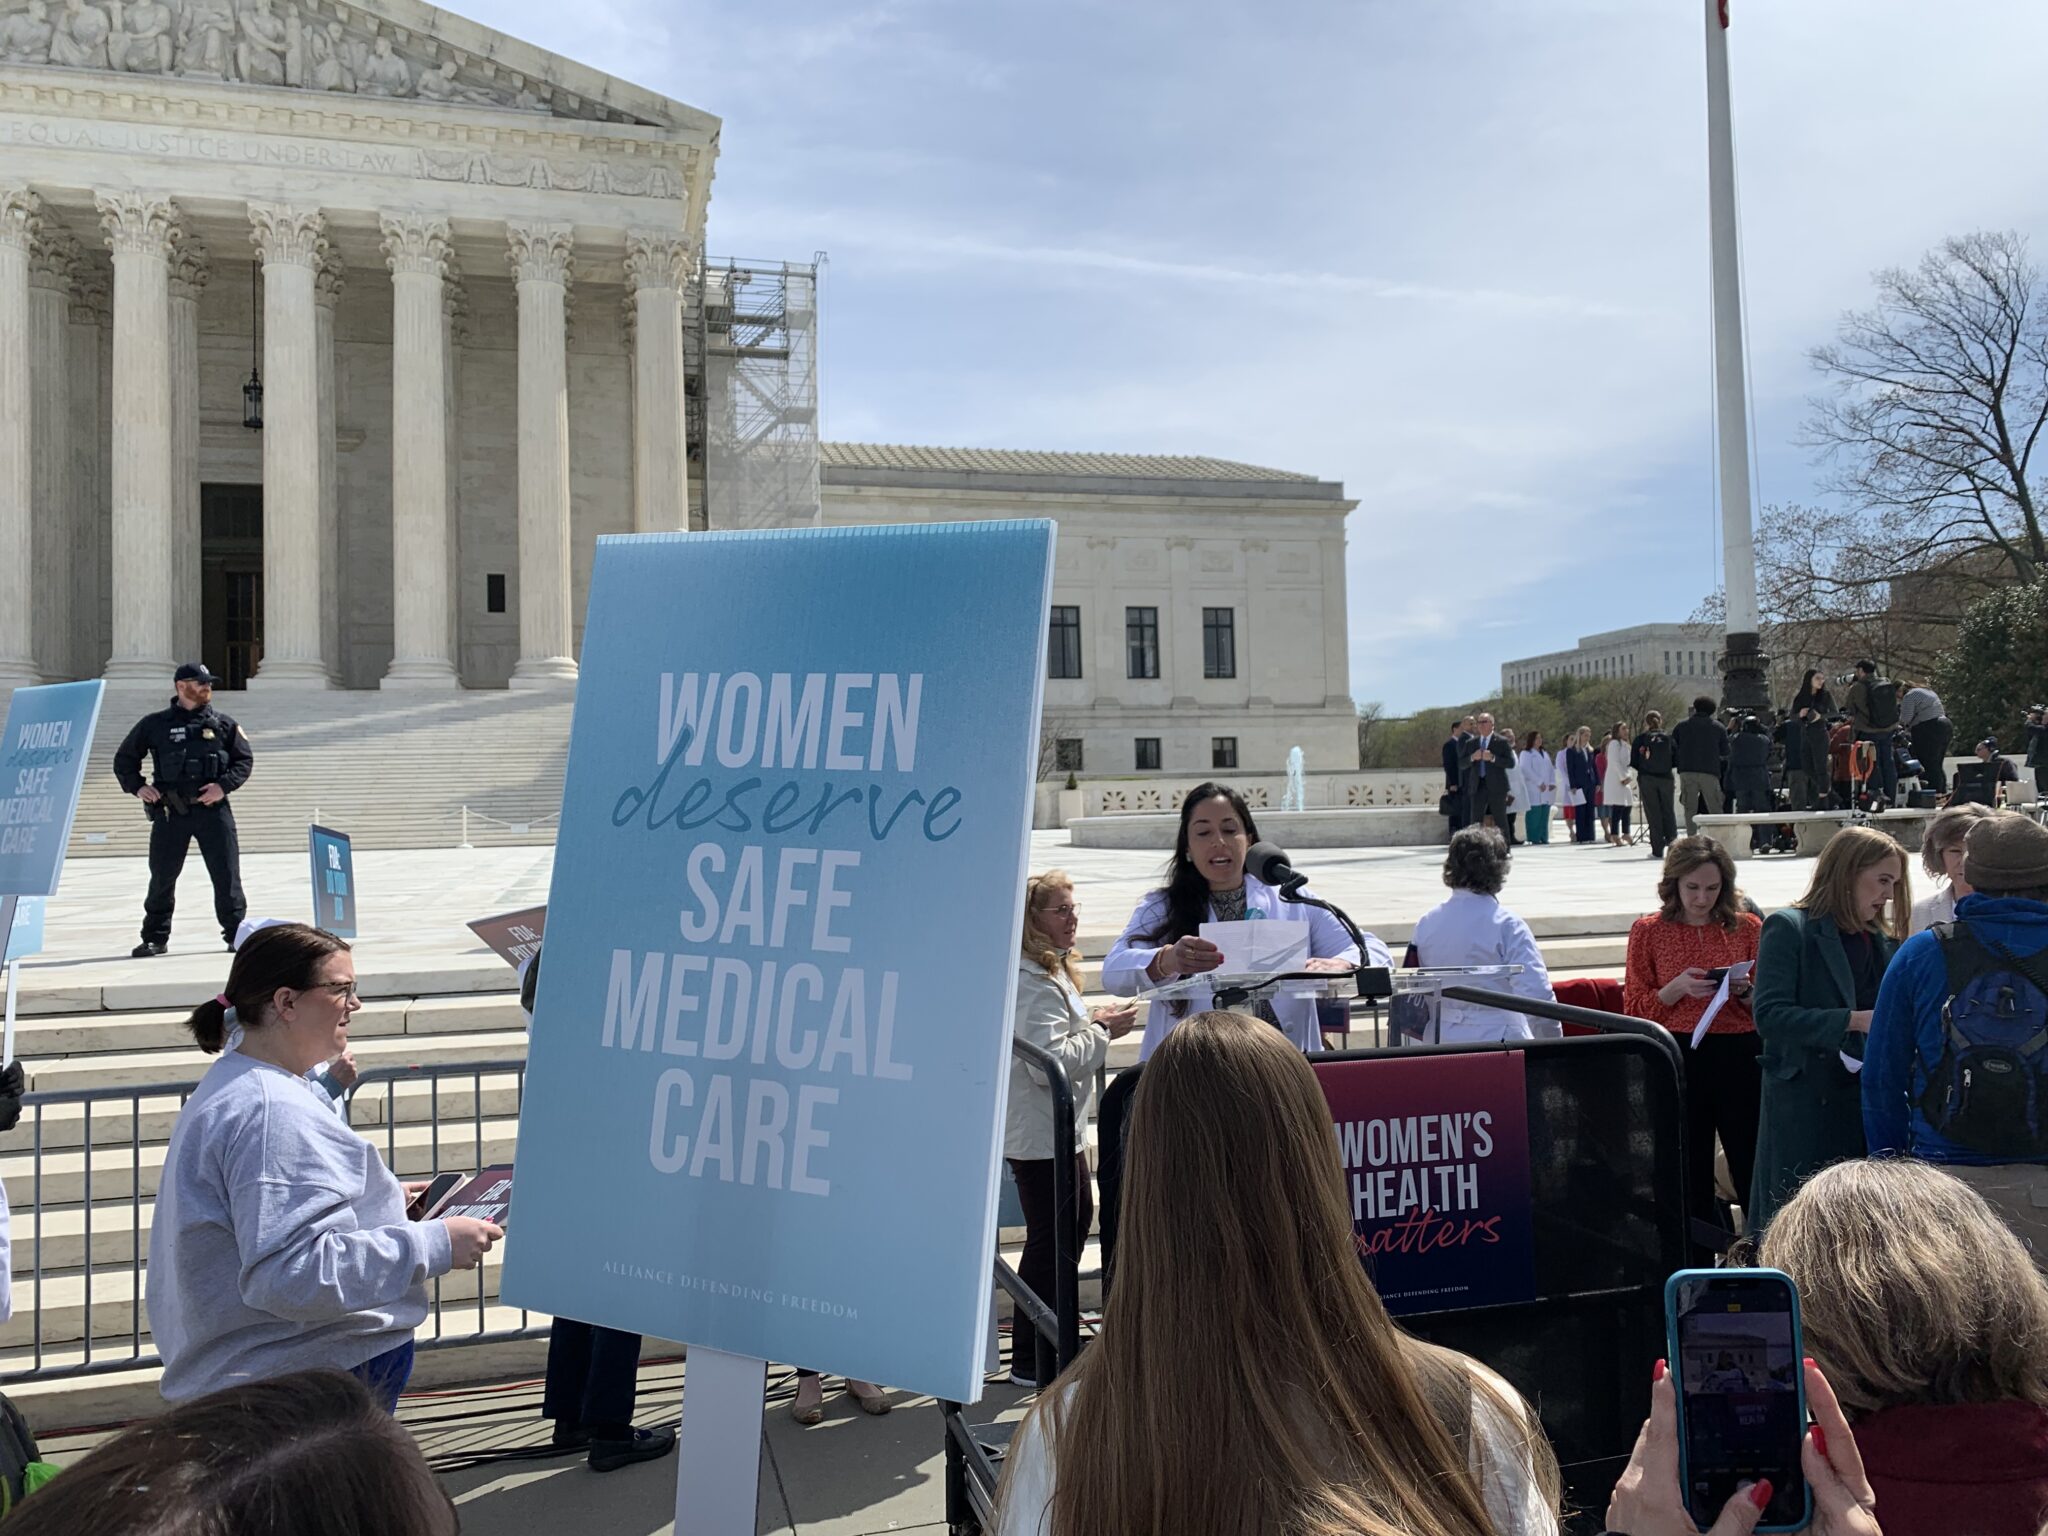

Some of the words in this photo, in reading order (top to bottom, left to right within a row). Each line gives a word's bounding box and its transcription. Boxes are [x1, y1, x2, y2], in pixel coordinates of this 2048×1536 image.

[11, 121, 110, 148] EQUAL
[118, 131, 229, 158] JUSTICE
[243, 141, 336, 166] UNDER
[346, 150, 397, 171] LAW
[18, 720, 72, 750] WOMEN
[656, 672, 923, 772] WOMEN
[5, 737, 73, 768] deserve
[15, 768, 53, 795] SAFE
[612, 723, 962, 841] deserve
[0, 796, 54, 825] MEDICAL
[1, 826, 39, 855] CARE
[680, 842, 861, 953] SAFE
[602, 949, 914, 1081] MEDICAL
[650, 1068, 840, 1197] CARE
[1334, 1111, 1494, 1168] WOMEN'S
[1353, 1163, 1479, 1220] HEALTH
[602, 1261, 674, 1285] ALLIANCE
[680, 1275, 773, 1304] DEFENDING
[781, 1294, 859, 1320] FREEDOM
